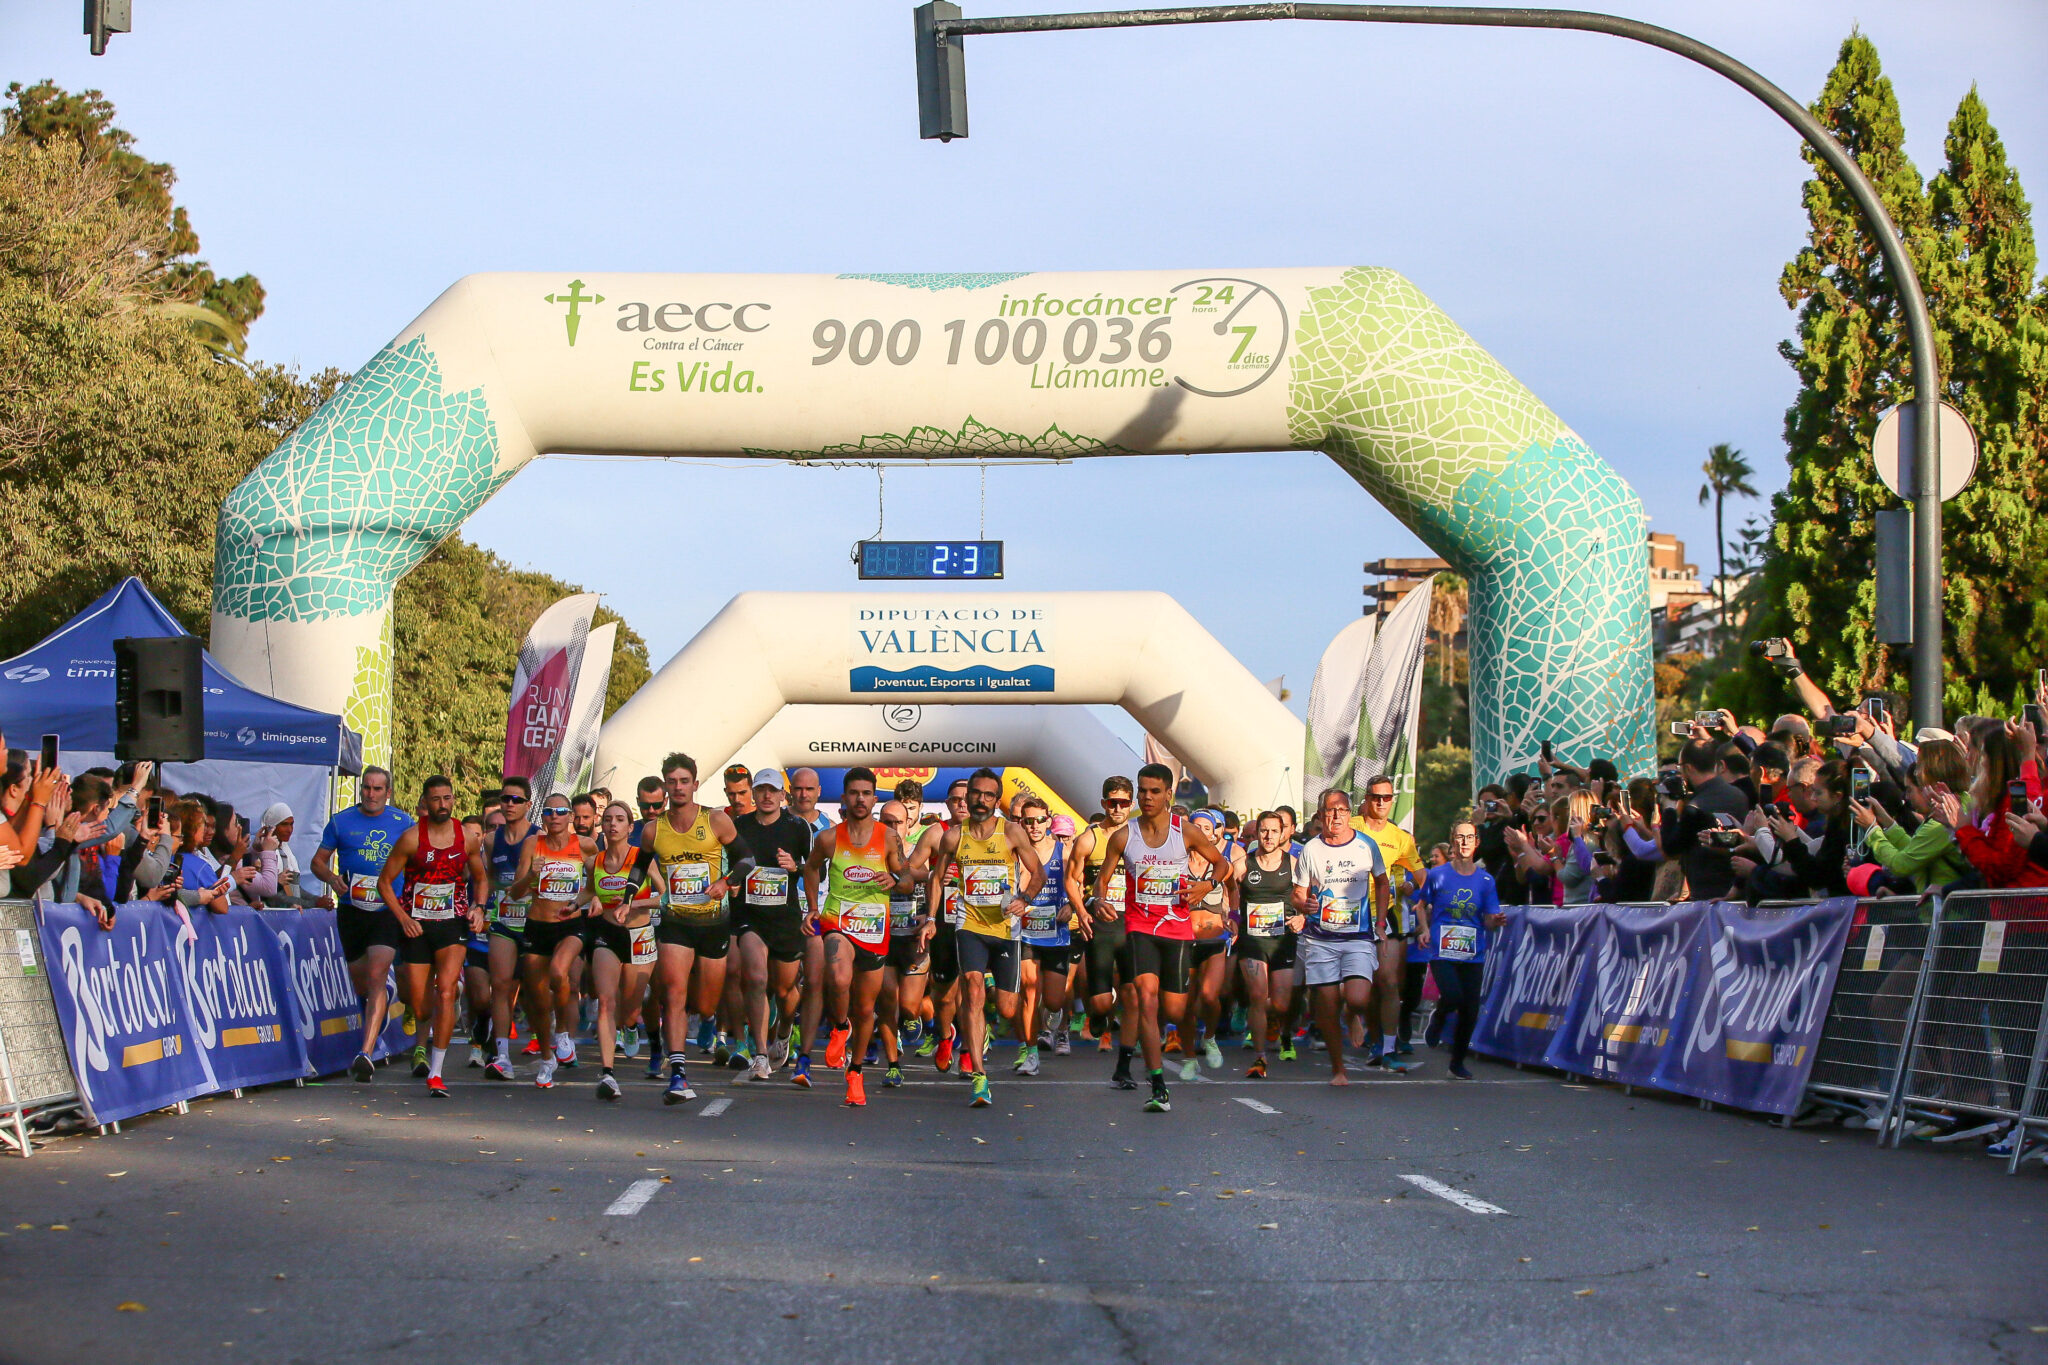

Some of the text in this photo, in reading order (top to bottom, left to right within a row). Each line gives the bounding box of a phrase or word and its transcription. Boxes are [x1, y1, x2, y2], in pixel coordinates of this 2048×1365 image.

[1192, 285, 1235, 305] 24
[999, 292, 1178, 317] infocáncer
[616, 301, 772, 333] aecc
[643, 337, 745, 352] Contra el Cáncer
[811, 316, 1172, 366] 900 100 036
[1228, 325, 1270, 364] 7 días
[628, 360, 764, 393] Es Vida.
[1030, 362, 1171, 389] Llámame.
[859, 607, 1044, 621] DIPUTACIÓ DE
[858, 624, 1046, 653] VALÈNCIA
[873, 676, 928, 689] Joventut,
[929, 676, 976, 689] Esports
[986, 676, 1031, 689] Igualtat
[529, 684, 567, 706] RUN
[220, 730, 229, 739] by
[262, 732, 327, 744] timingsense
[808, 741, 997, 753] GERMAINE DE CAPUCCINI
[846, 869, 873, 879] Serrano
[546, 881, 574, 893] 3020
[675, 879, 703, 894] 2930
[753, 882, 779, 895] 3163
[971, 882, 1000, 895] 2598
[1143, 881, 1172, 895] 2509
[364, 890, 376, 902] 10
[422, 897, 446, 910] 1874
[505, 905, 526, 918] 3118
[1328, 911, 1352, 924] 3123
[846, 918, 877, 933] 3044
[1446, 939, 1470, 952] 3974
